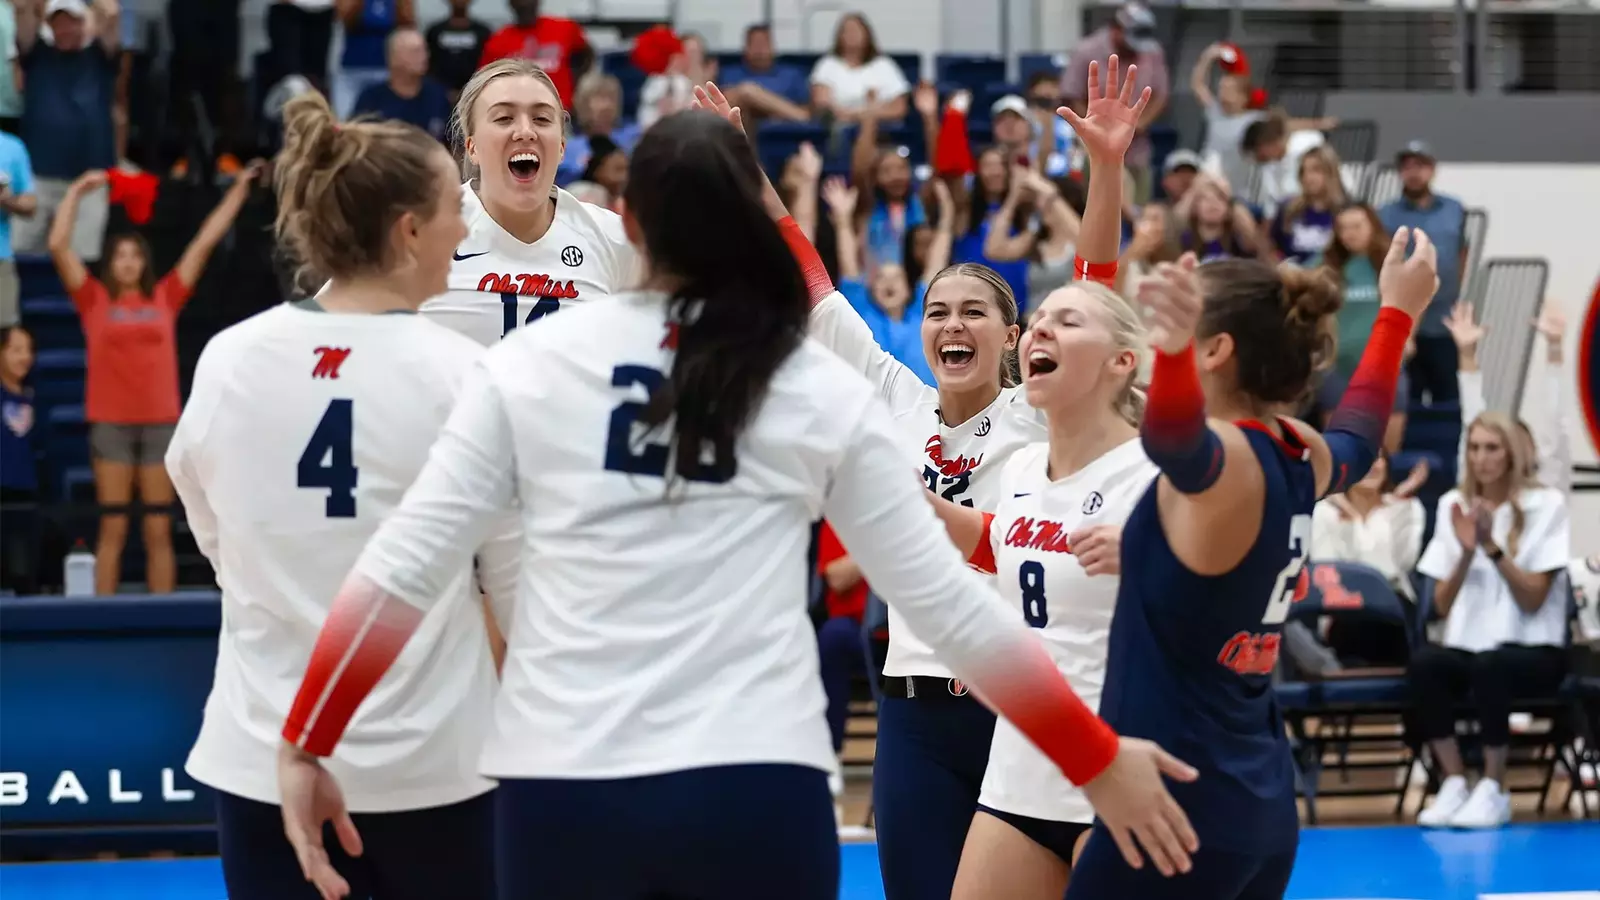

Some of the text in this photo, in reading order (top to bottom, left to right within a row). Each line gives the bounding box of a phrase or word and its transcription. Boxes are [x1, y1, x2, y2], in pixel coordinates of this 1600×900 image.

[561, 246, 583, 267] SEC
[477, 272, 579, 299] Ole Miss
[312, 346, 352, 379] M
[297, 398, 358, 517] 4
[1004, 516, 1074, 554] Ole Mis
[1019, 560, 1048, 629] 8
[0, 767, 196, 806] BALL
